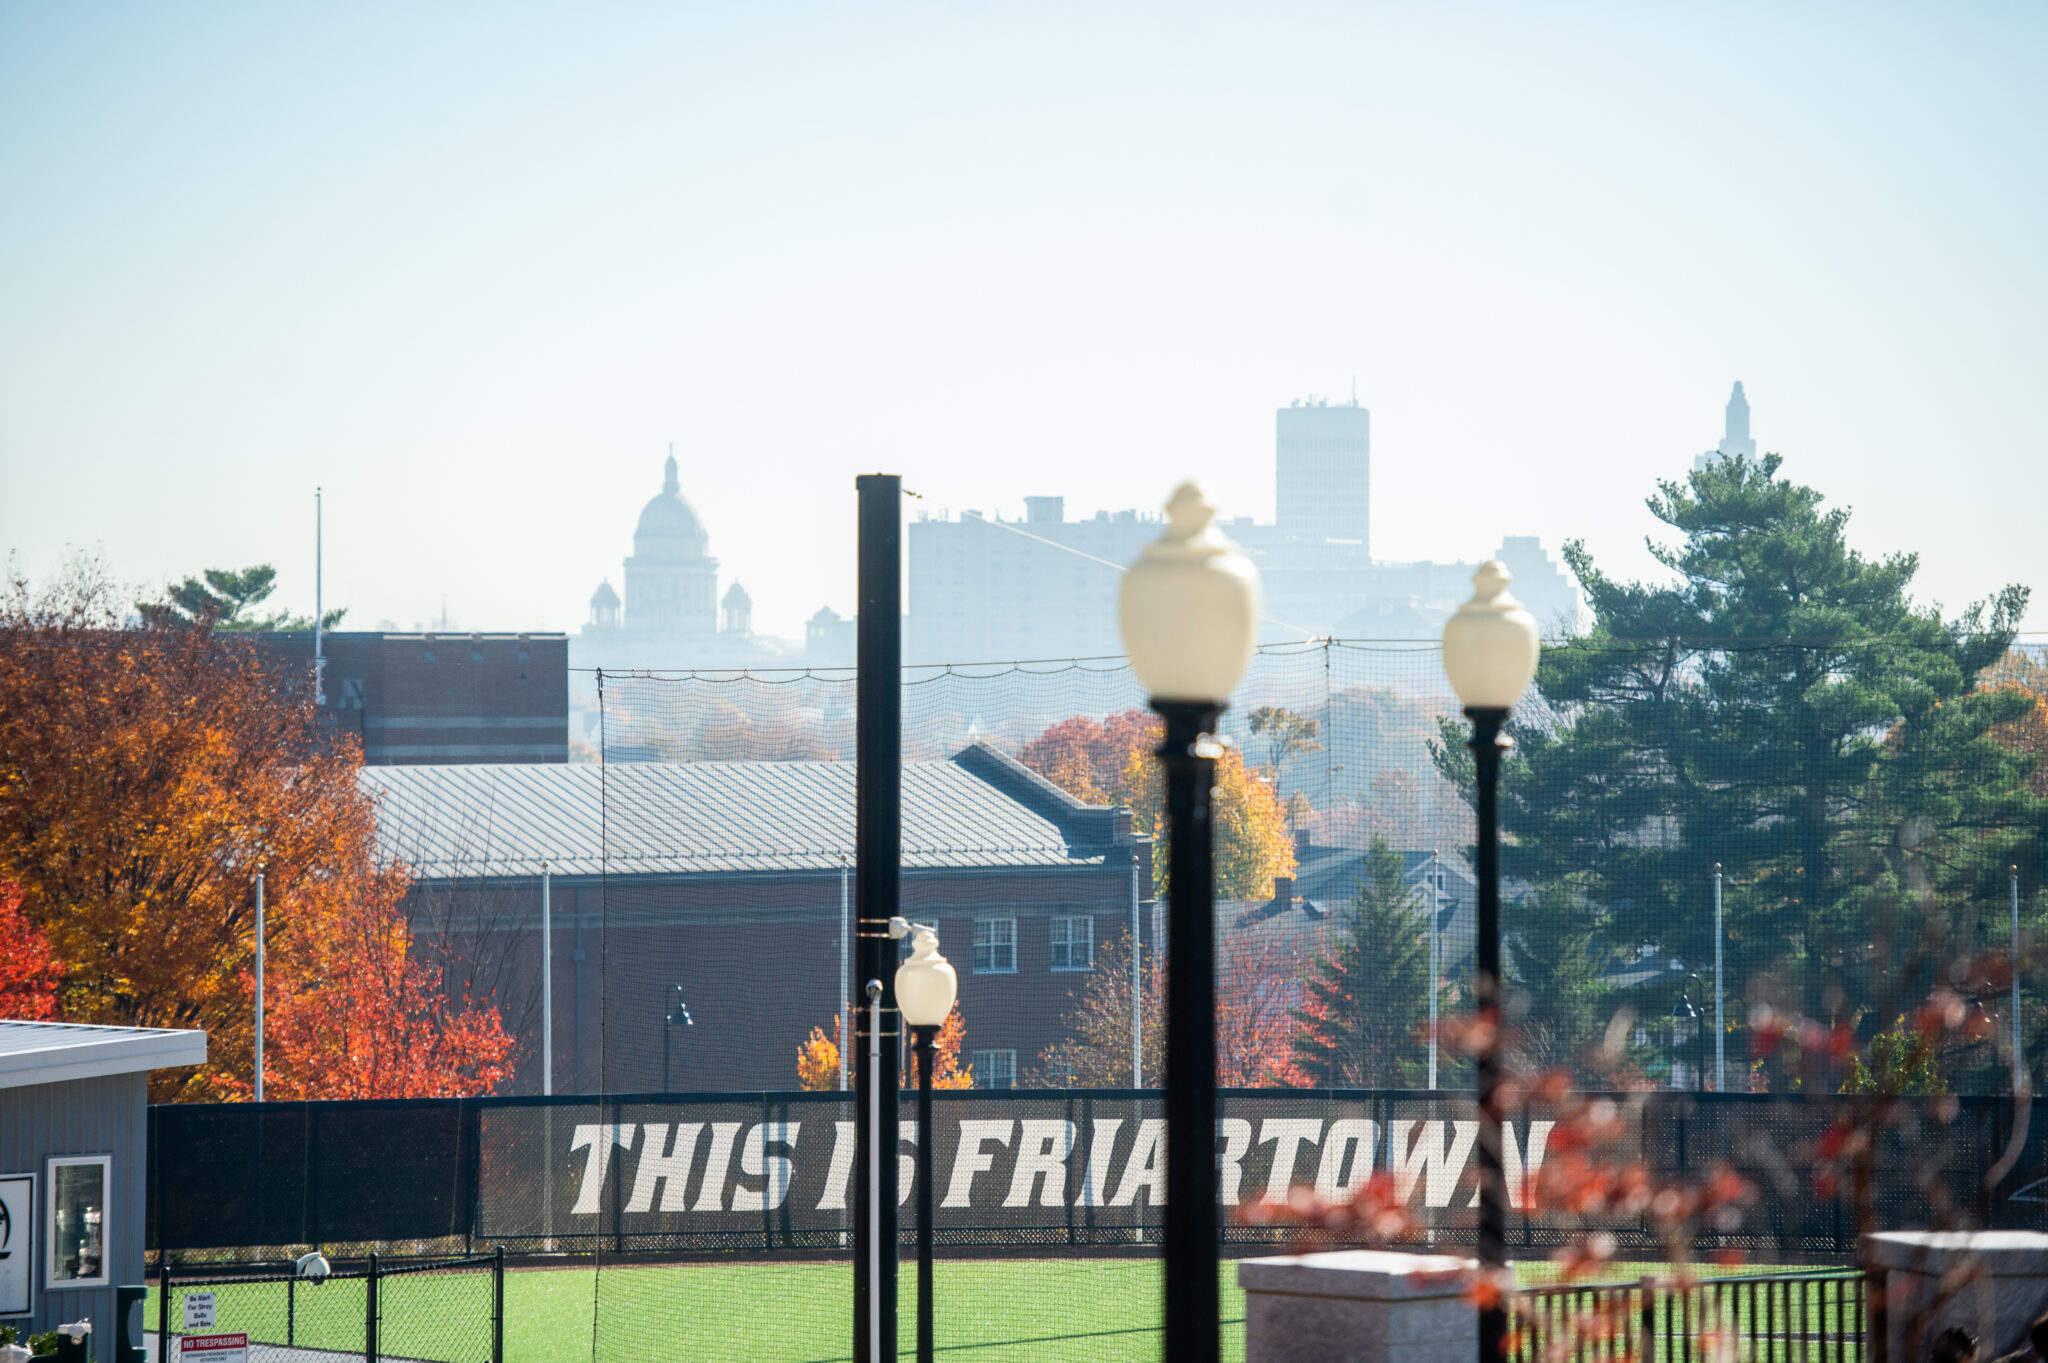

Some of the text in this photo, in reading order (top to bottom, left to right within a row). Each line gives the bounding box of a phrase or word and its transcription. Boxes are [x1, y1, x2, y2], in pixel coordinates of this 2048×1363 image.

[570, 1121, 801, 1214] THIS
[183, 1336, 245, 1349] NO TRESPASSING
